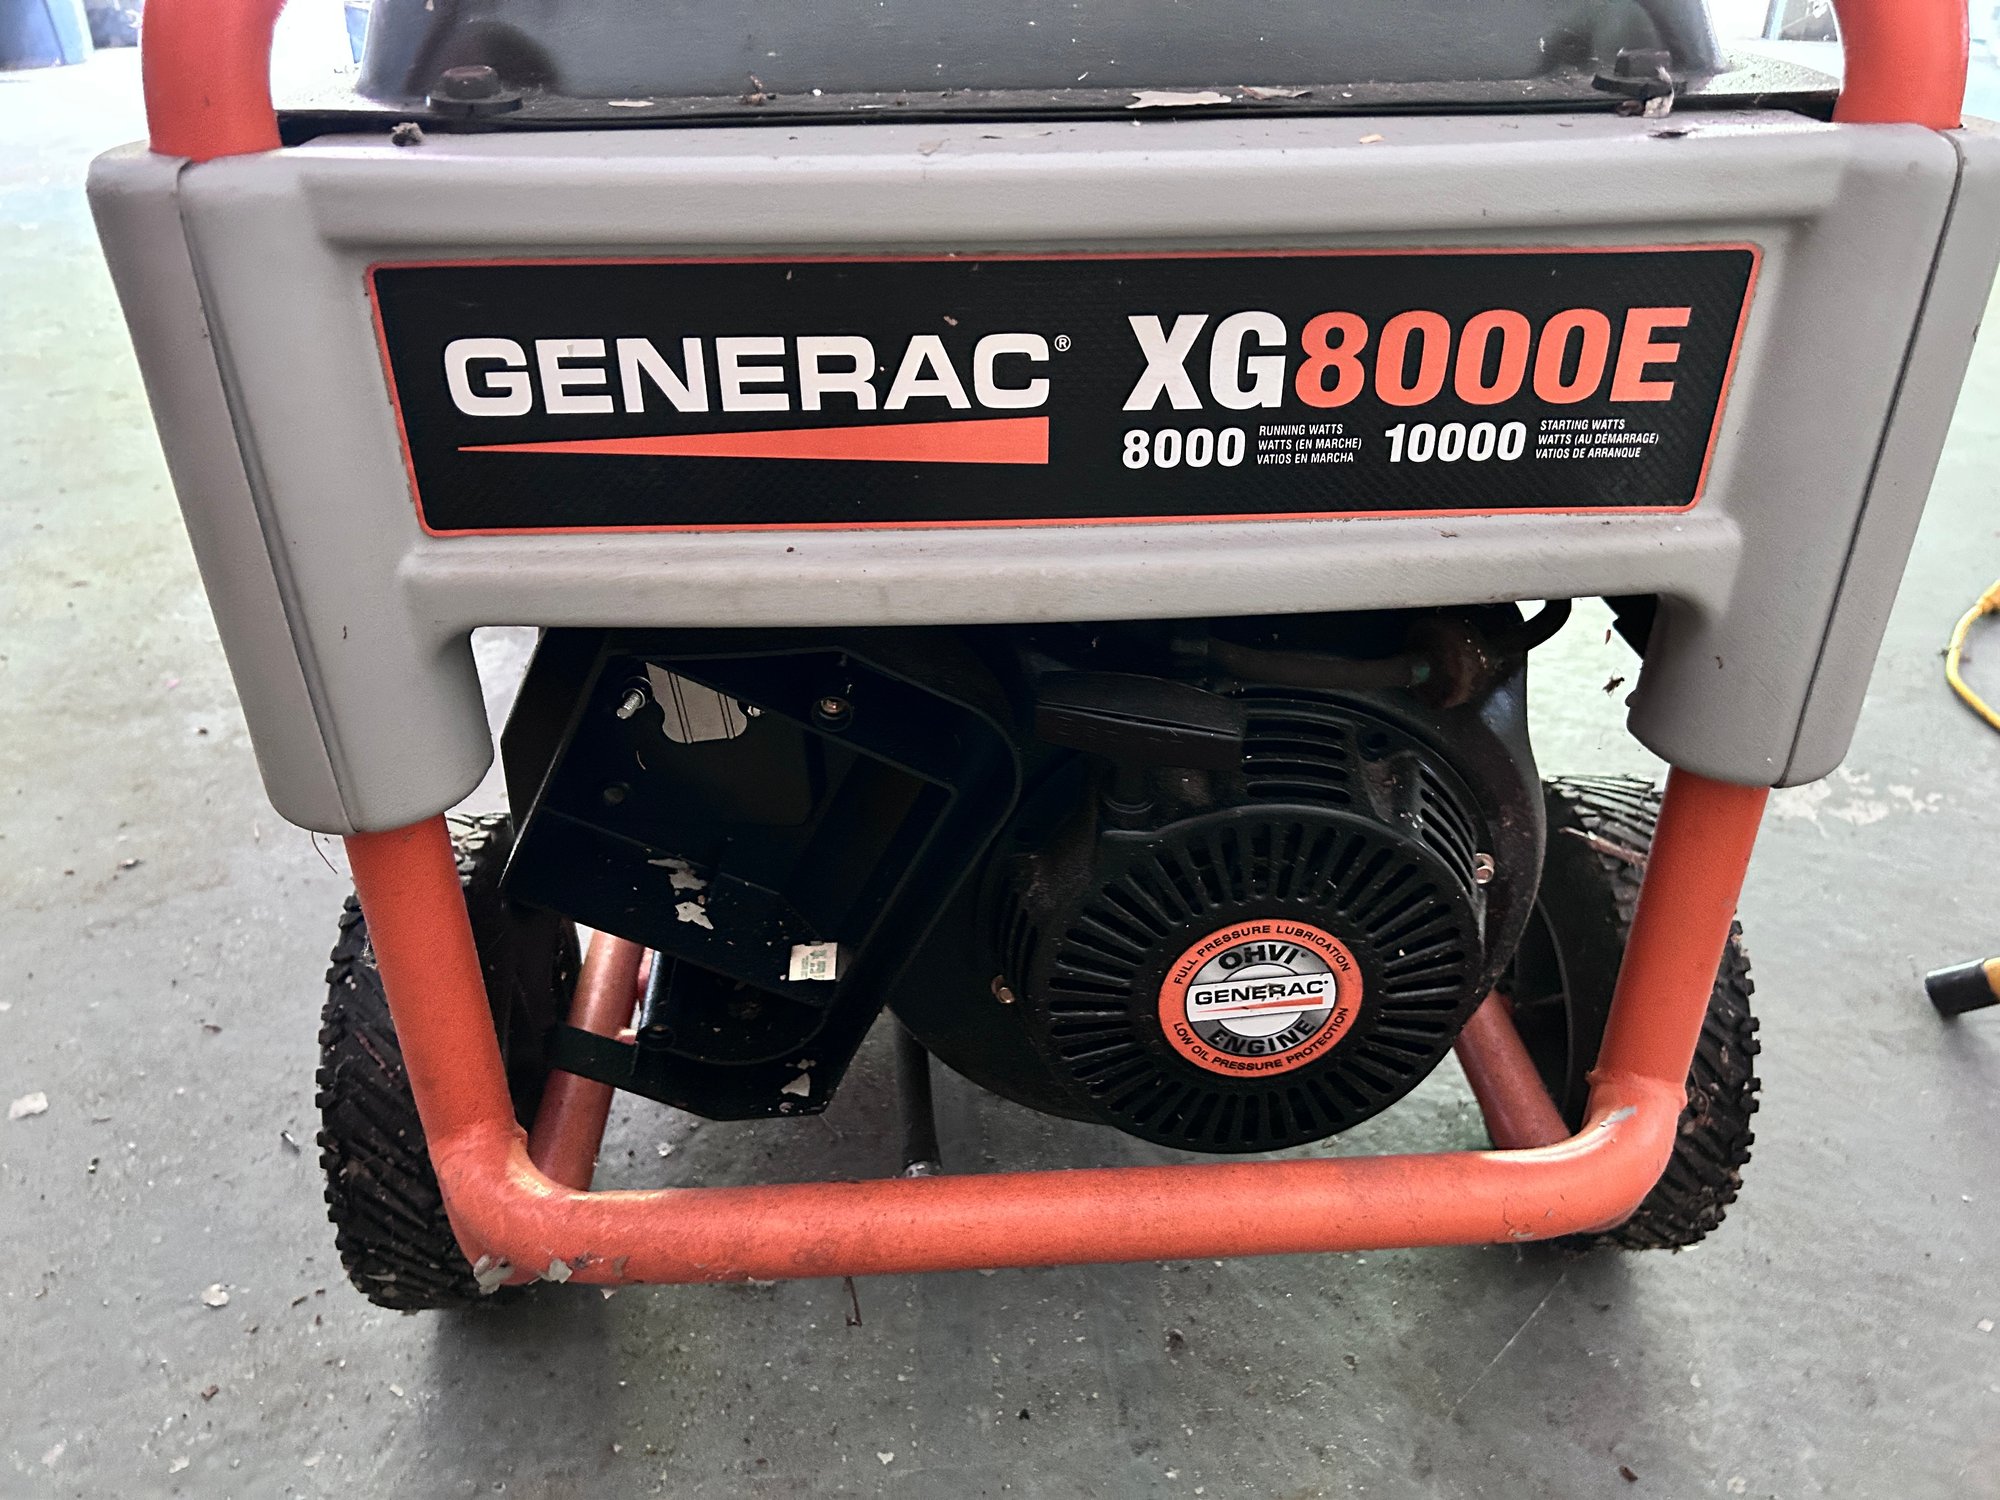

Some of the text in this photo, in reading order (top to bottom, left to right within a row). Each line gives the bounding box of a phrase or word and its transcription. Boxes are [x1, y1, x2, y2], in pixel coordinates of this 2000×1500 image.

[1122, 306, 1692, 411] XG8000E
[1259, 423, 1344, 436] RUNNING WATTS
[1540, 418, 1625, 431] STARTING WATTS
[1122, 427, 1246, 469] 8000
[1258, 437, 1362, 451] WATTS (EN MARCHE)
[1384, 421, 1526, 463] 10000
[1538, 430, 1659, 446] WATTS (AU DÉMARRAGE)
[1257, 452, 1354, 465] VATIOS EN MARCHA
[1535, 446, 1642, 459] VATIOS DE ARRANQUE
[1173, 925, 1351, 985] FULL PRESSURE LUBRICATION
[1195, 980, 1326, 1005] GENERAC
[1173, 1007, 1349, 1071] LOW OIL PRESSURE PROTECTION
[1207, 1019, 1316, 1054] ENGINE
